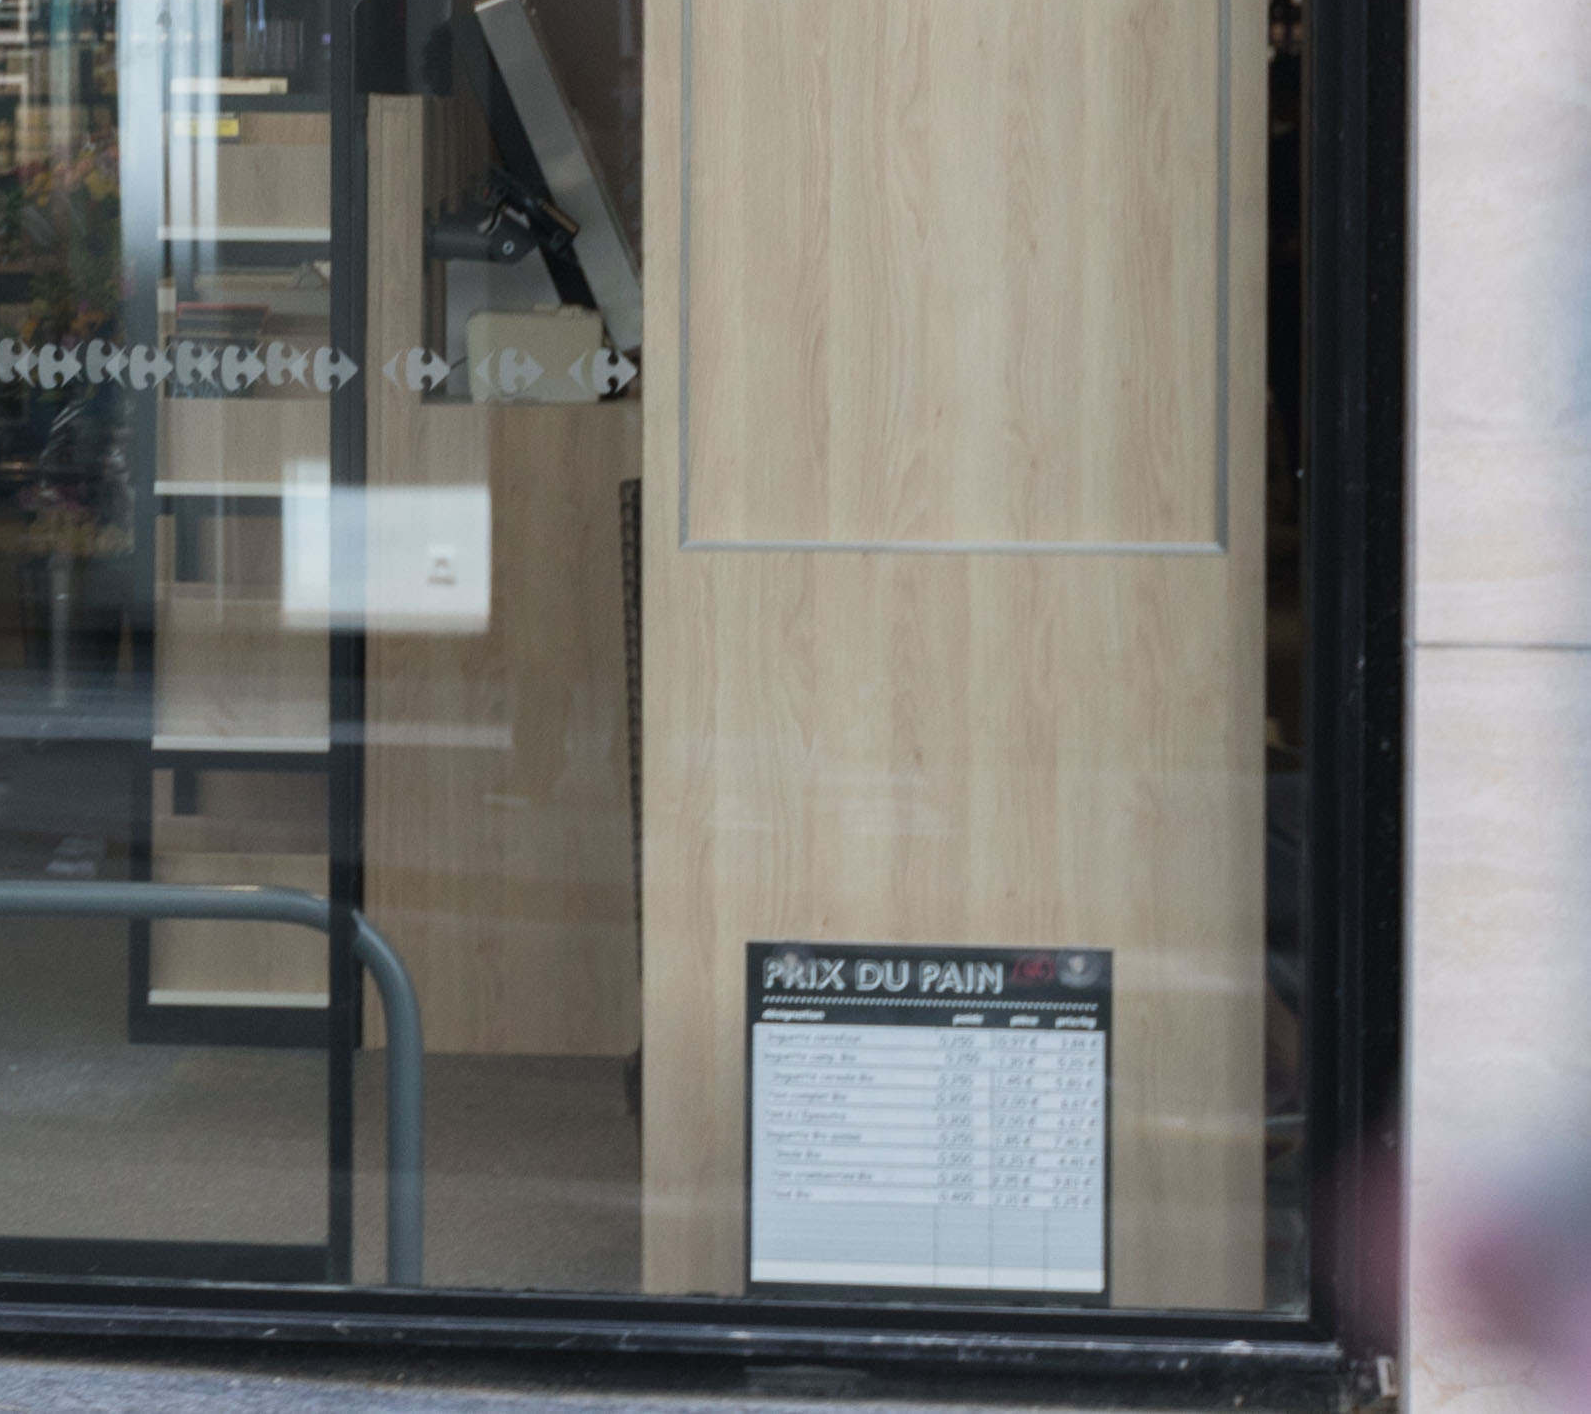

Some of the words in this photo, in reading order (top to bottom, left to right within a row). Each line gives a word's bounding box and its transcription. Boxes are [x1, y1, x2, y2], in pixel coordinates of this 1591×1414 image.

[762, 957, 847, 991] PRIX
[854, 959, 910, 992] DU
[918, 960, 1004, 995] PAIN
